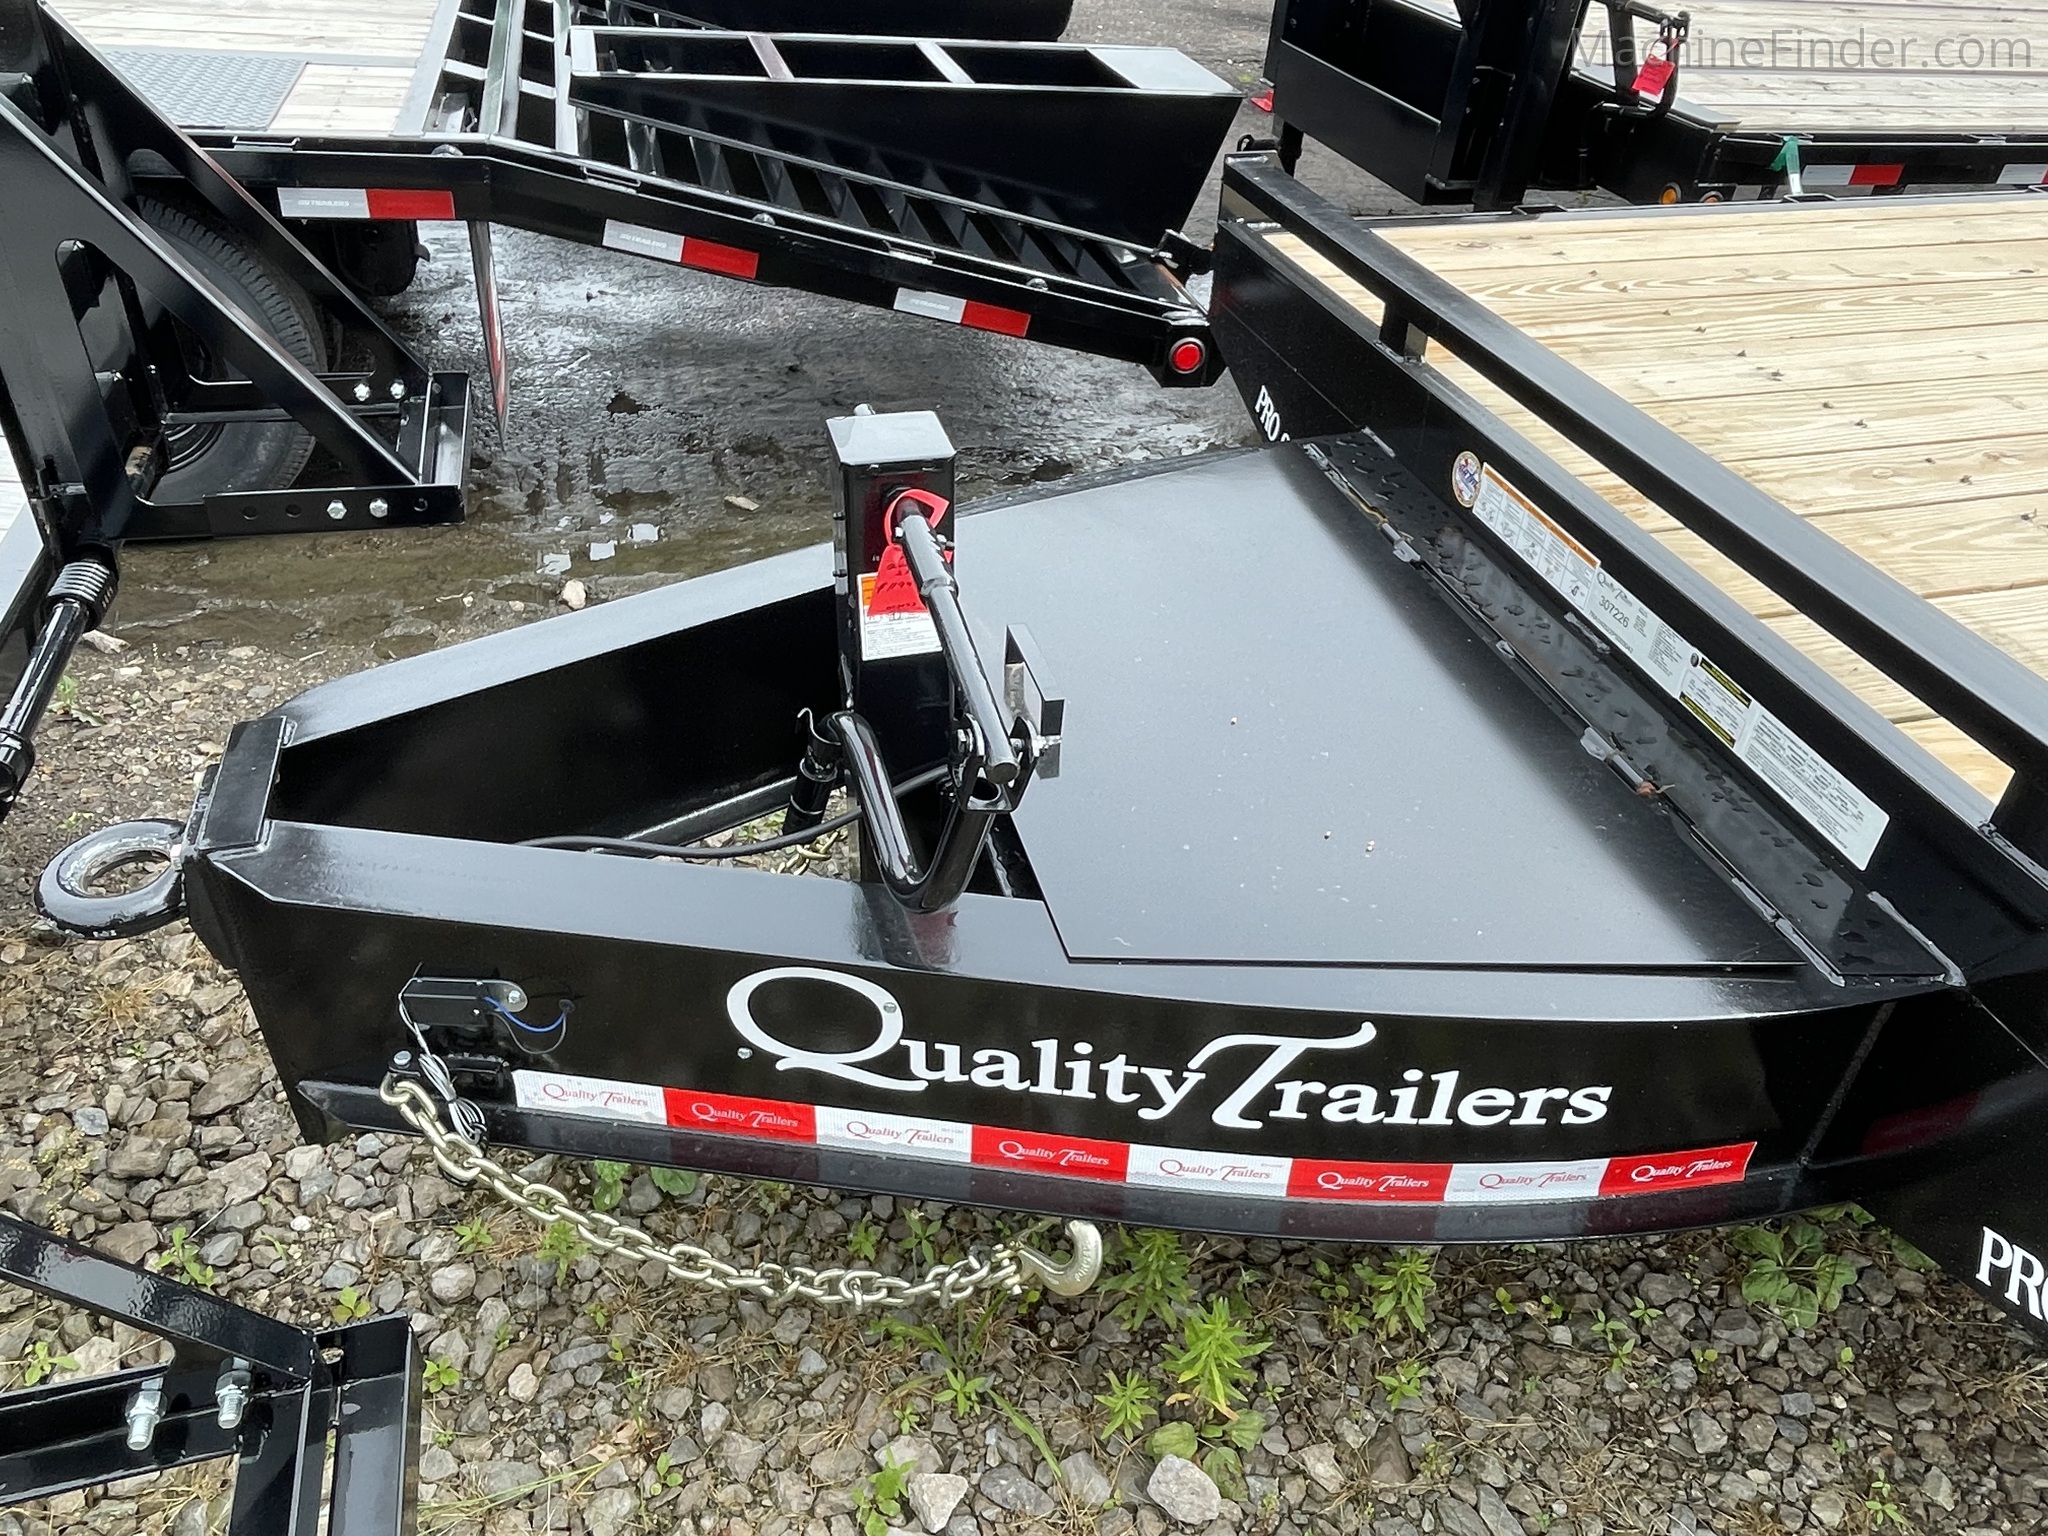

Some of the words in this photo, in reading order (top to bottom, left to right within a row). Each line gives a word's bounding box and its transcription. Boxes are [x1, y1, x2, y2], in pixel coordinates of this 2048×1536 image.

[1254, 384, 1281, 442] PRO
[1598, 595, 1630, 628] 307226
[726, 966, 1206, 1121] Quality
[1187, 1021, 1613, 1129] Trailers
[543, 1083, 597, 1102] Quality
[600, 1091, 649, 1107] Trailers
[691, 1102, 747, 1122] Quality
[749, 1110, 799, 1128] Trailers
[846, 1121, 902, 1139] Quality
[905, 1128, 954, 1144] Trailers
[998, 1140, 1056, 1160] Quality
[1058, 1148, 1110, 1166] Trailers
[1159, 1159, 1217, 1177] Quality
[1219, 1165, 1271, 1181] Trailers
[1317, 1171, 1376, 1190] Quality
[1378, 1175, 1430, 1192] Trailers
[1480, 1173, 1535, 1189] Quality
[1537, 1172, 1587, 1188] Trailers
[1631, 1165, 1686, 1182] Quality
[1685, 1159, 1733, 1178] Trailers
[1975, 1225, 2048, 1323] PR
